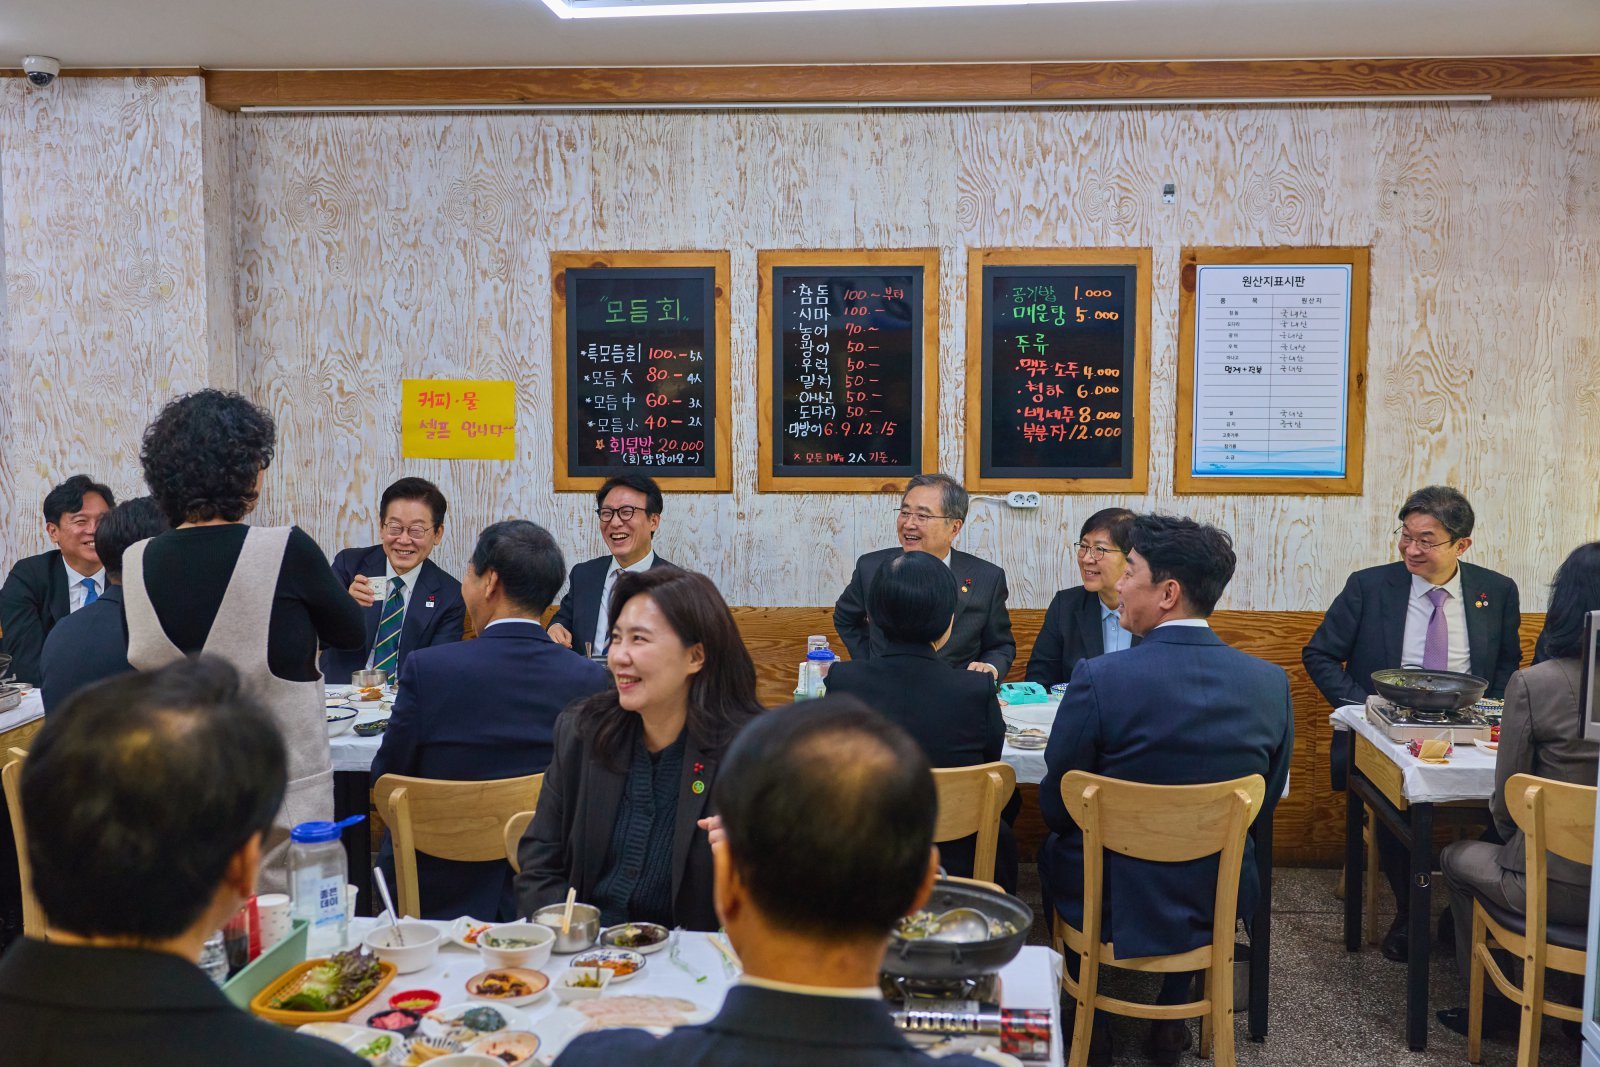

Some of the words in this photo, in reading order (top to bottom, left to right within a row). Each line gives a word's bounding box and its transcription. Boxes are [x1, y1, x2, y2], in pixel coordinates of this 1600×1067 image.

[1242, 276, 1306, 288] 원산지표시판
[882, 286, 904, 301] 부터
[1012, 285, 1057, 303] 공기밥
[1073, 285, 1113, 301] 1.000
[799, 307, 832, 321] 시마
[1013, 303, 1067, 326] 매운탕
[1075, 306, 1119, 323] 5.000
[799, 322, 828, 340] 농어
[588, 343, 641, 363] 특모듬회
[1015, 333, 1050, 356] 주류
[802, 358, 828, 374] 우럭
[1083, 365, 1120, 380] 4.000
[592, 370, 617, 388] 모듬
[800, 373, 831, 389] 밀치
[799, 391, 834, 404] 아나고
[1025, 380, 1065, 403] 청하
[1076, 384, 1120, 399] 6.000
[594, 394, 618, 411] 모듬
[622, 392, 636, 412] 中
[799, 405, 836, 420] 도다리
[1078, 406, 1121, 423] 8.000
[419, 418, 450, 440] 셀프
[598, 417, 623, 433] 모듬
[1023, 422, 1068, 444] 복분자
